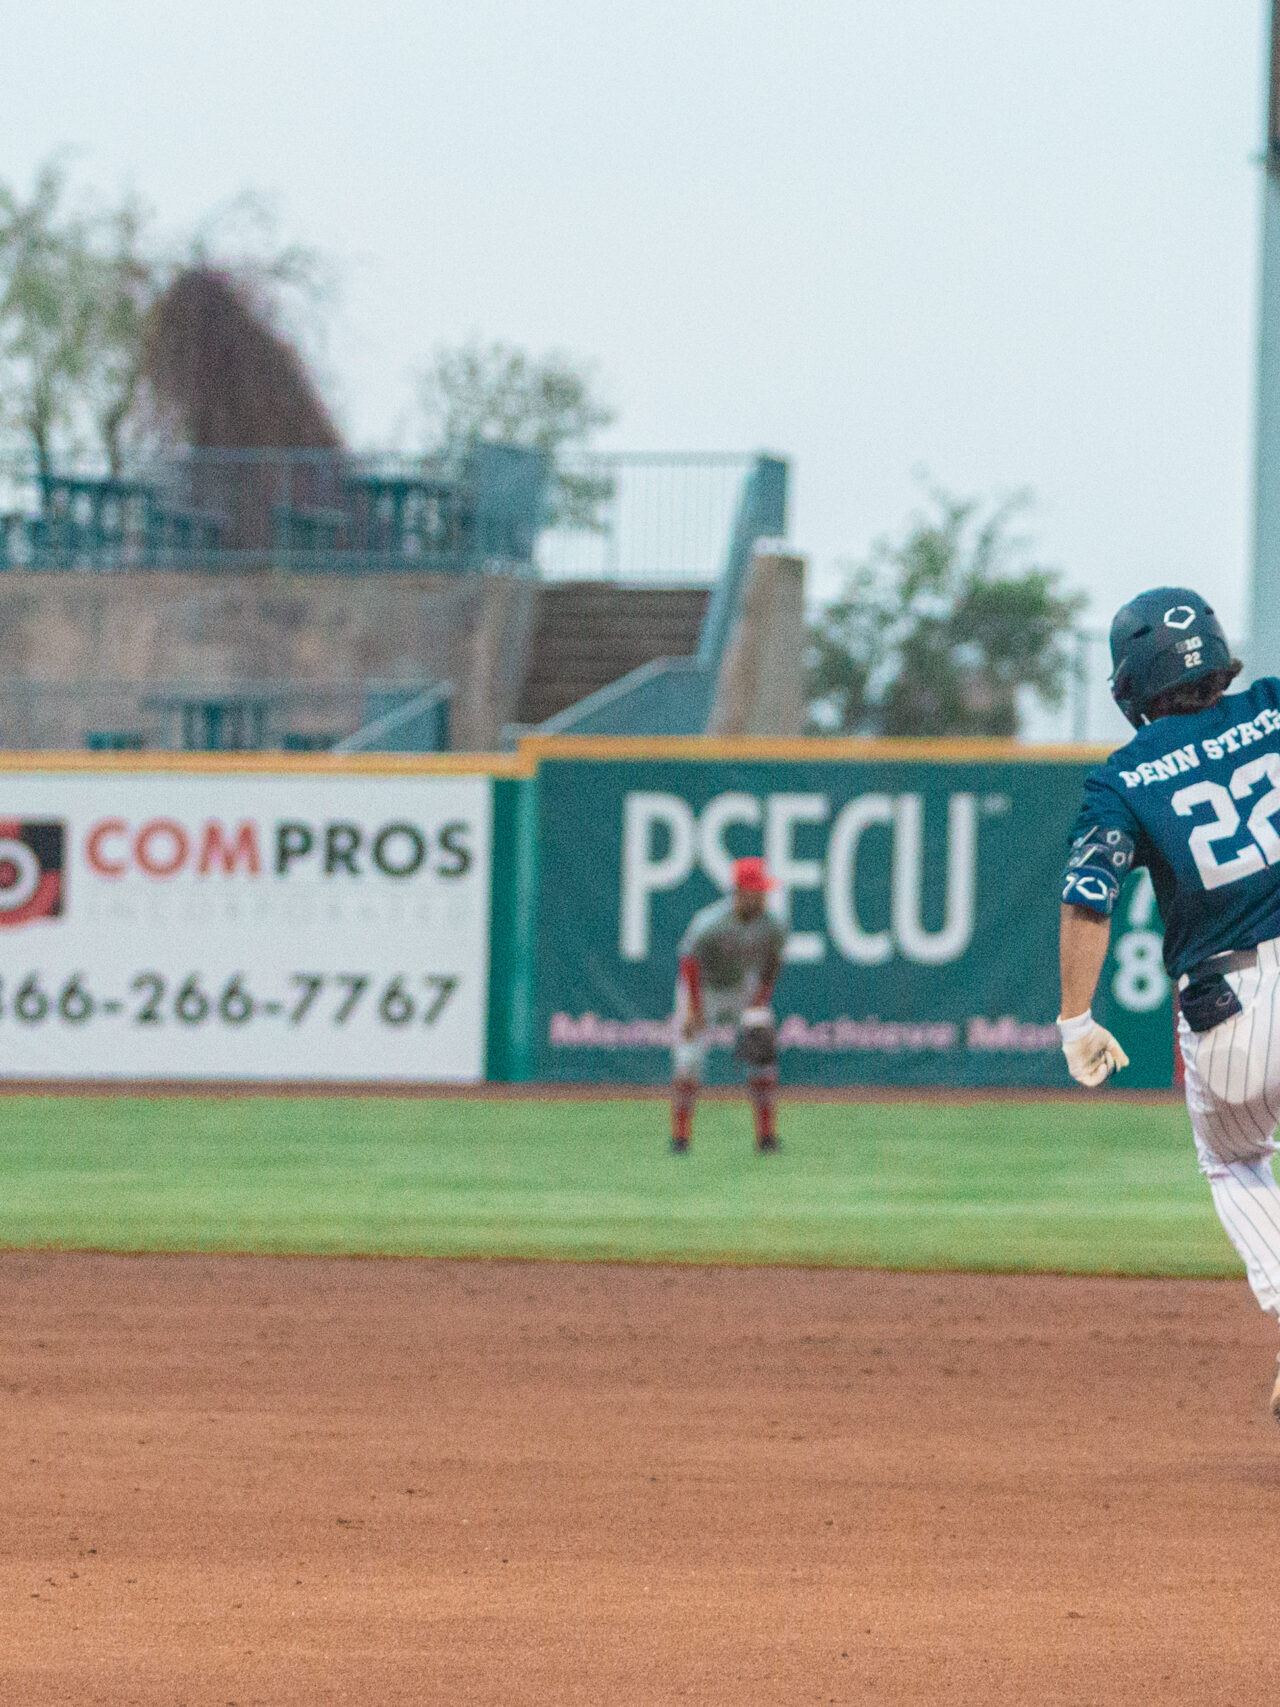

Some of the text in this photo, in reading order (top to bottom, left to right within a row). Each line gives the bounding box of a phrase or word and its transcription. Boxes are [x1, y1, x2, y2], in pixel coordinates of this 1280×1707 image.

[1184, 651, 1203, 668] 22
[1118, 744, 1201, 788] PENN
[84, 817, 473, 879] COMPROS
[619, 791, 978, 966] PSECU
[0, 970, 460, 1026] 66-266-7767
